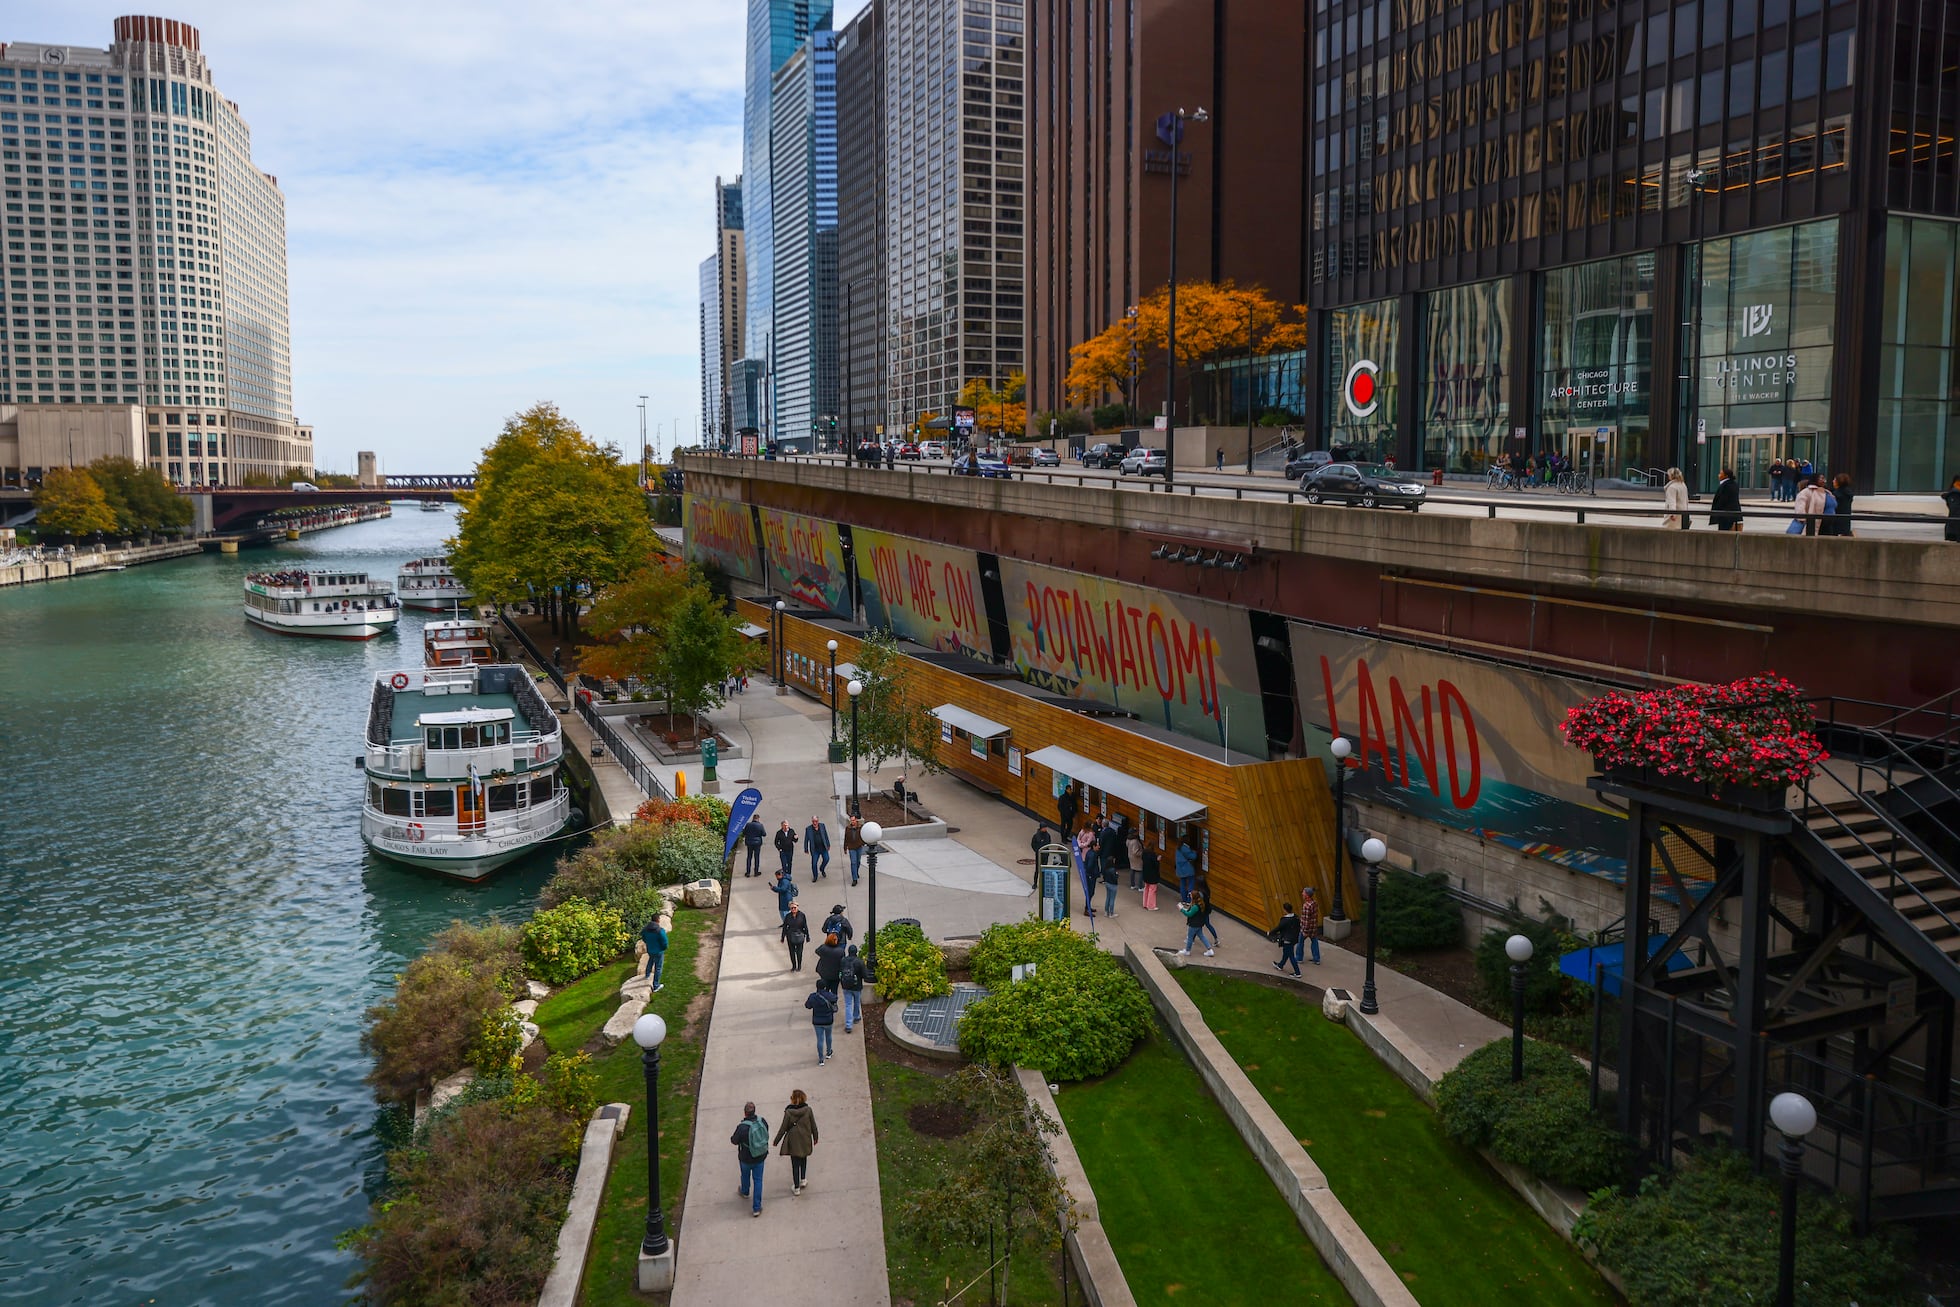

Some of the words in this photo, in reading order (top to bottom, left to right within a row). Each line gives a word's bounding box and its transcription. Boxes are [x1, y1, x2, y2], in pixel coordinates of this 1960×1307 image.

[1716, 354, 1796, 373] ILLINOIS
[1577, 371, 1608, 380] CHICAGO
[1715, 371, 1795, 389] CENTER
[1550, 381, 1638, 398] ARCHITECTURE
[1749, 392, 1780, 400] WACKER
[1577, 400, 1608, 409] CENTER
[869, 546, 903, 606] YOU
[907, 549, 941, 622] ARE
[944, 561, 979, 635] ON
[1026, 581, 1220, 721] POTAWATOMI
[1320, 655, 1481, 809] LAND
[429, 846, 449, 855] LADY
